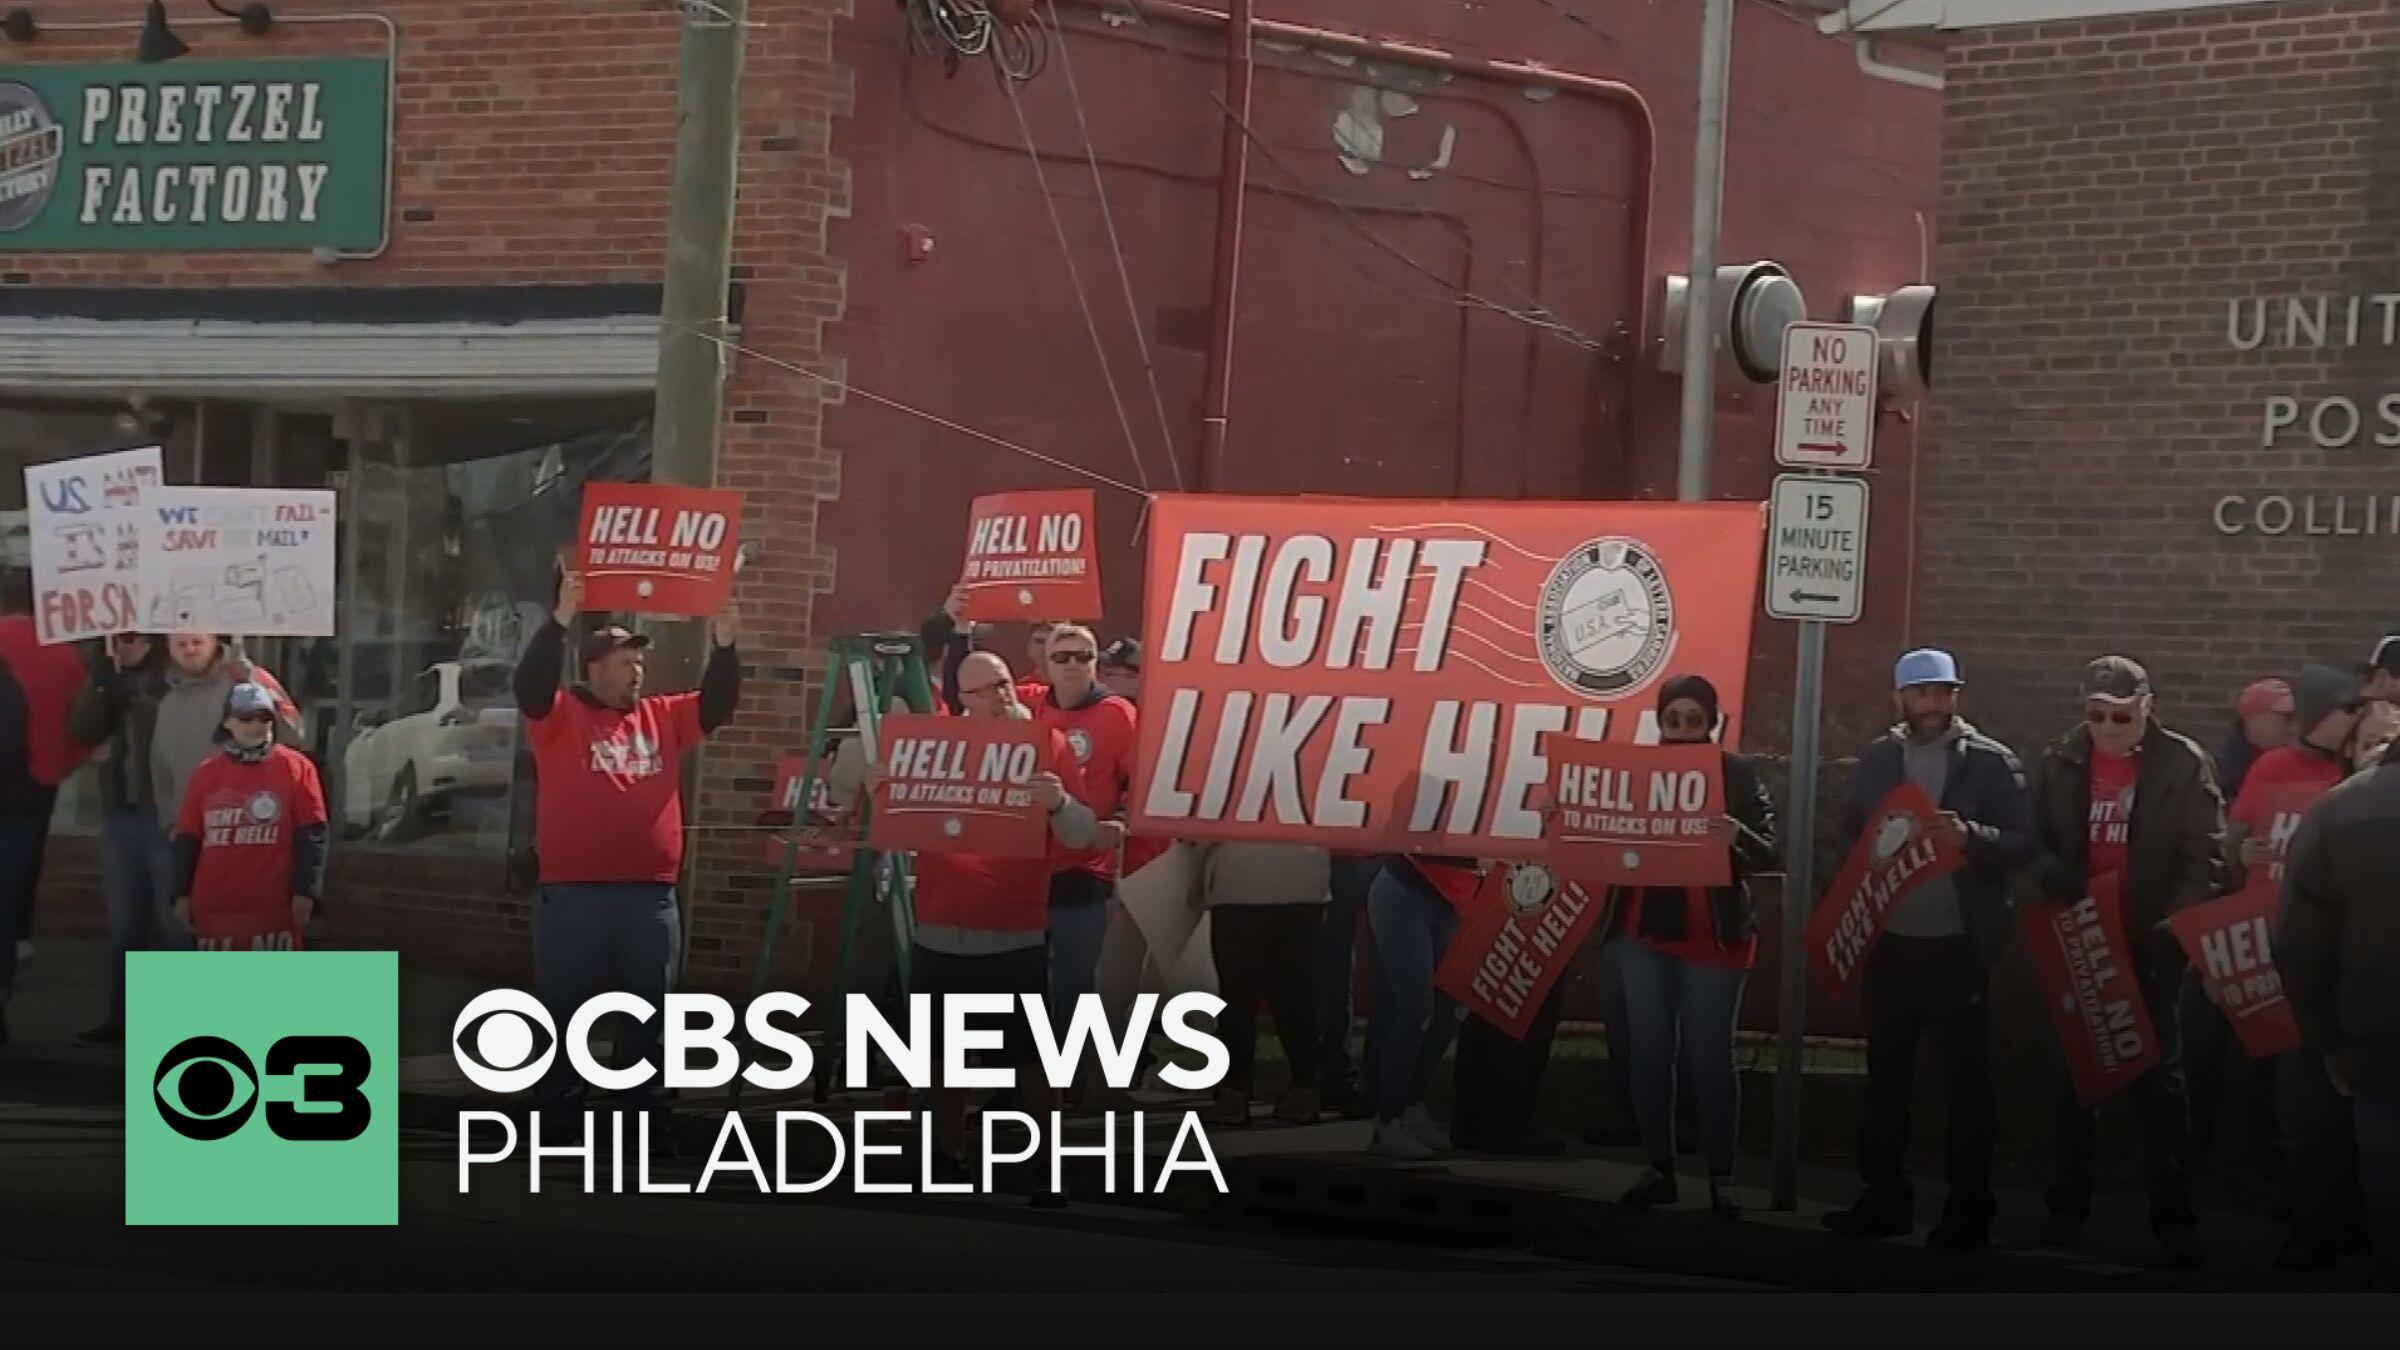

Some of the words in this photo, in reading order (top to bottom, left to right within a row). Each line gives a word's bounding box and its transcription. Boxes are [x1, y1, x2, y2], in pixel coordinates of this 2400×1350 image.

[81, 82, 324, 144] PRETZEL
[80, 164, 329, 223] FACTORY
[1812, 336, 1846, 364] NO
[1788, 365, 1866, 397] PARKING
[1803, 417, 1847, 437] TIME
[1808, 398, 1844, 417] ANY
[40, 476, 91, 514] US
[1805, 495, 1834, 521] 15
[589, 505, 661, 545] HELL
[670, 510, 727, 550] NO
[970, 514, 1029, 556] HELL
[1037, 512, 1082, 553] NO
[1780, 527, 1853, 552] MINUTE
[589, 548, 604, 565] TO
[606, 548, 667, 567] ATTACKS
[668, 552, 692, 569] ON
[966, 559, 979, 578] TO
[981, 557, 1086, 578] PRIVATIZATION!
[1776, 555, 1854, 582] PARKING
[41, 586, 97, 640] FOR
[1160, 531, 1487, 673] FIGHT
[888, 737, 967, 781] HELL
[978, 741, 1038, 784] NO
[1144, 688, 1390, 827] LIKE
[888, 782, 905, 801] TO
[908, 783, 976, 804] ATTACKS
[977, 785, 1002, 805] ON
[1559, 762, 1634, 812] HELL
[1648, 770, 1706, 812] NO
[1564, 810, 1581, 828] TO
[1583, 812, 1647, 835] ATTACKS
[1651, 817, 1676, 835] ON
[1826, 870, 1875, 966] FIGHT
[1836, 906, 1875, 982] LIKE
[1872, 837, 1938, 912] HELL!
[1472, 916, 1526, 1003] FIGHT
[1496, 950, 1543, 1020] LIKE
[1531, 880, 1591, 958] HELL!
[2074, 898, 2120, 990] HELL
[2104, 999, 2144, 1061] NO
